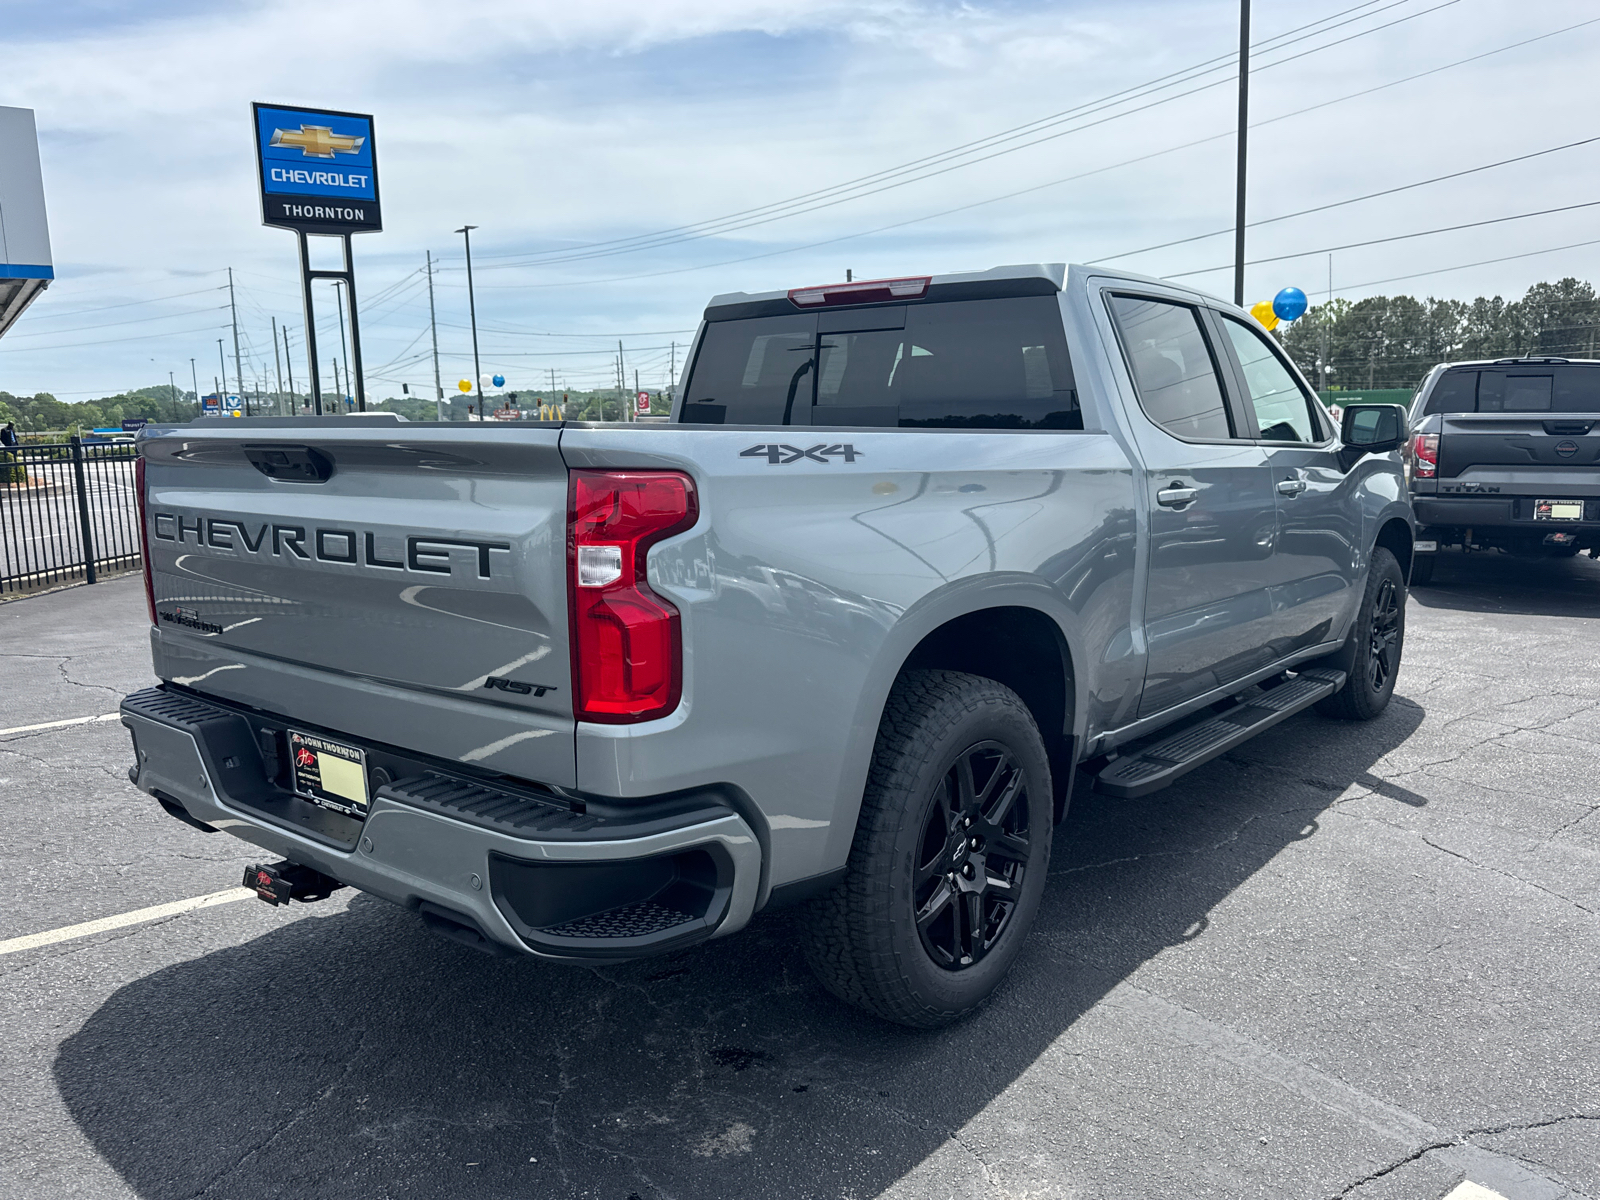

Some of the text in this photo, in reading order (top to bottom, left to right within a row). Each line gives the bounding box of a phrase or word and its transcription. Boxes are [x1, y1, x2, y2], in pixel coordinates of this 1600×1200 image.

[271, 168, 368, 188] CHEVROLET
[283, 204, 364, 220] THORNTON
[154, 512, 511, 580] CHEVROLET
[484, 676, 557, 697] RST
[304, 736, 360, 760] JOHN THORNTON
[321, 800, 344, 812] CHEVROLET
